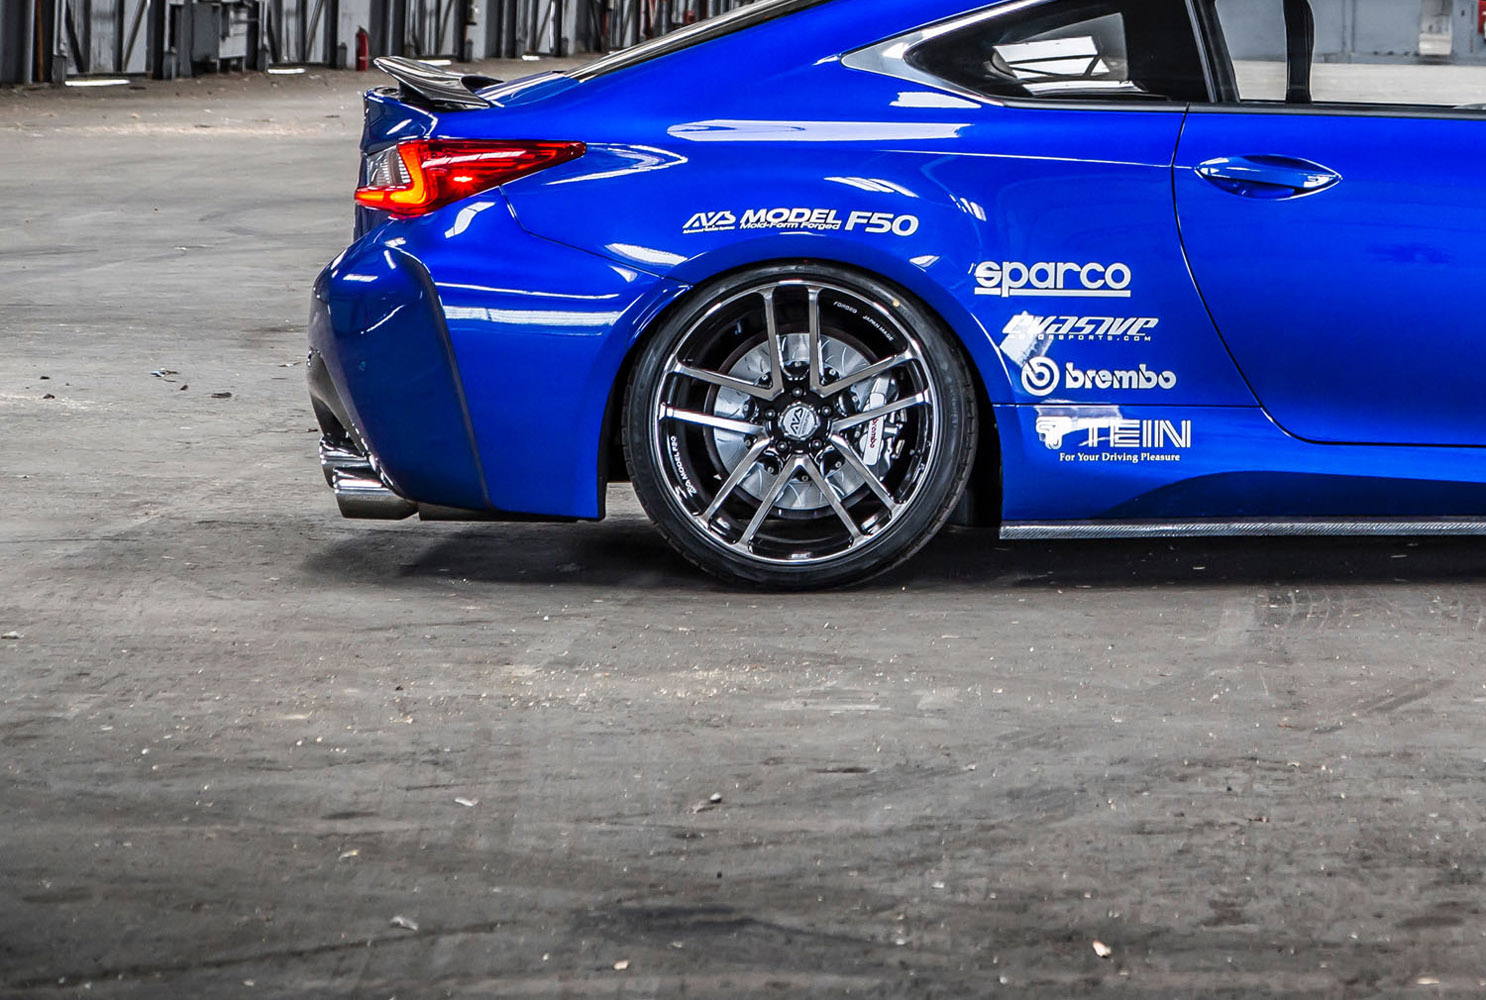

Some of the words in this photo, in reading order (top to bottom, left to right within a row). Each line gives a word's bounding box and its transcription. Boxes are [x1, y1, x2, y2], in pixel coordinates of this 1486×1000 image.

[740, 207, 843, 224] MODEL
[844, 210, 919, 236] F50
[800, 222, 842, 231] Forged
[974, 260, 1132, 298] sparco
[1065, 362, 1177, 390] brembo
[1077, 418, 1192, 448] TEIN
[674, 451, 688, 480] MODEL
[1059, 452, 1076, 462] For
[1077, 452, 1100, 462] Your
[1101, 452, 1139, 464] Driving
[1140, 452, 1181, 462] Pleasure
